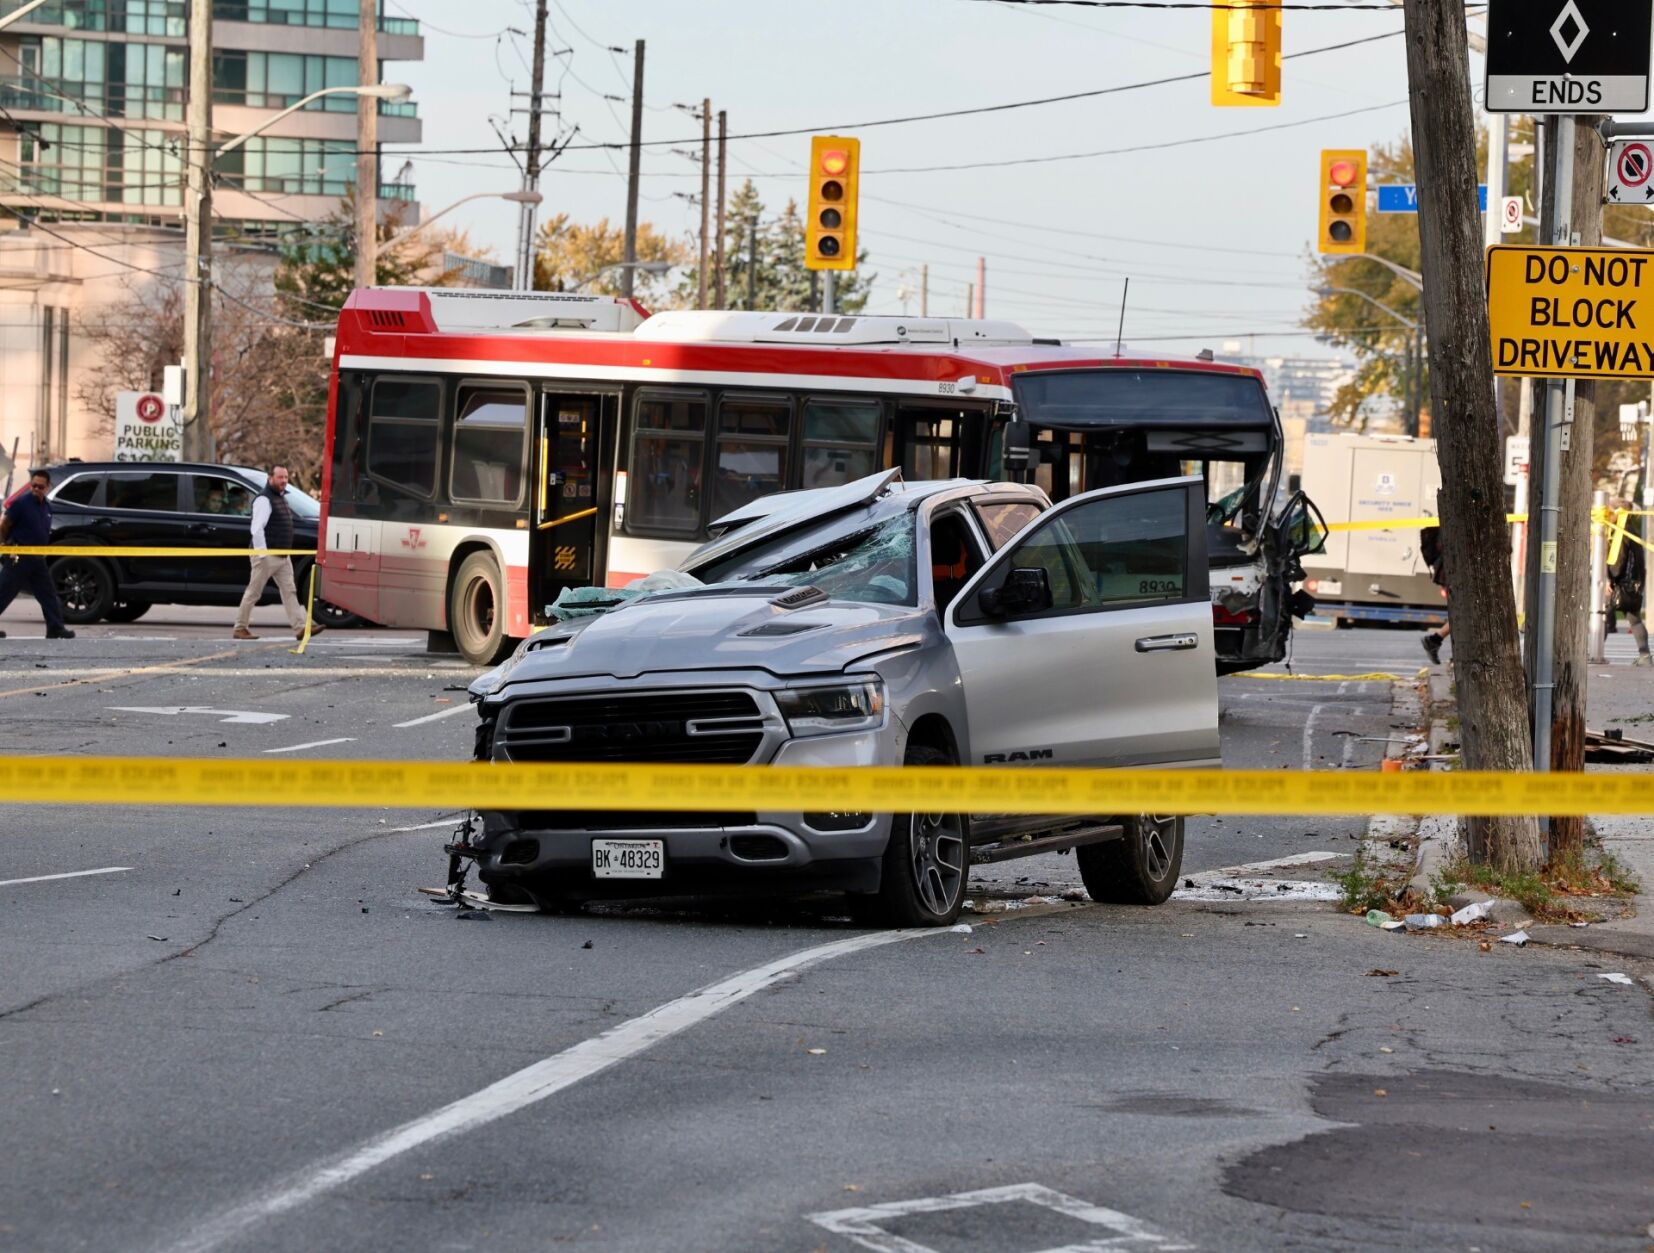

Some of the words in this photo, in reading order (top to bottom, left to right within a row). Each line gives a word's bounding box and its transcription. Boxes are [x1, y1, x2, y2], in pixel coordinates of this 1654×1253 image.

[1532, 80, 1602, 104] ENDS
[1525, 255, 1569, 285] DO
[1584, 257, 1648, 288] NOT
[1530, 297, 1637, 330] BLOCK
[938, 382, 955, 394] 8930
[124, 424, 176, 438] PUBLIC
[118, 437, 180, 451] PARKING
[1139, 580, 1175, 594] 8930
[984, 749, 1053, 764] RAM
[595, 849, 611, 868] BK
[620, 849, 660, 869] 48329
